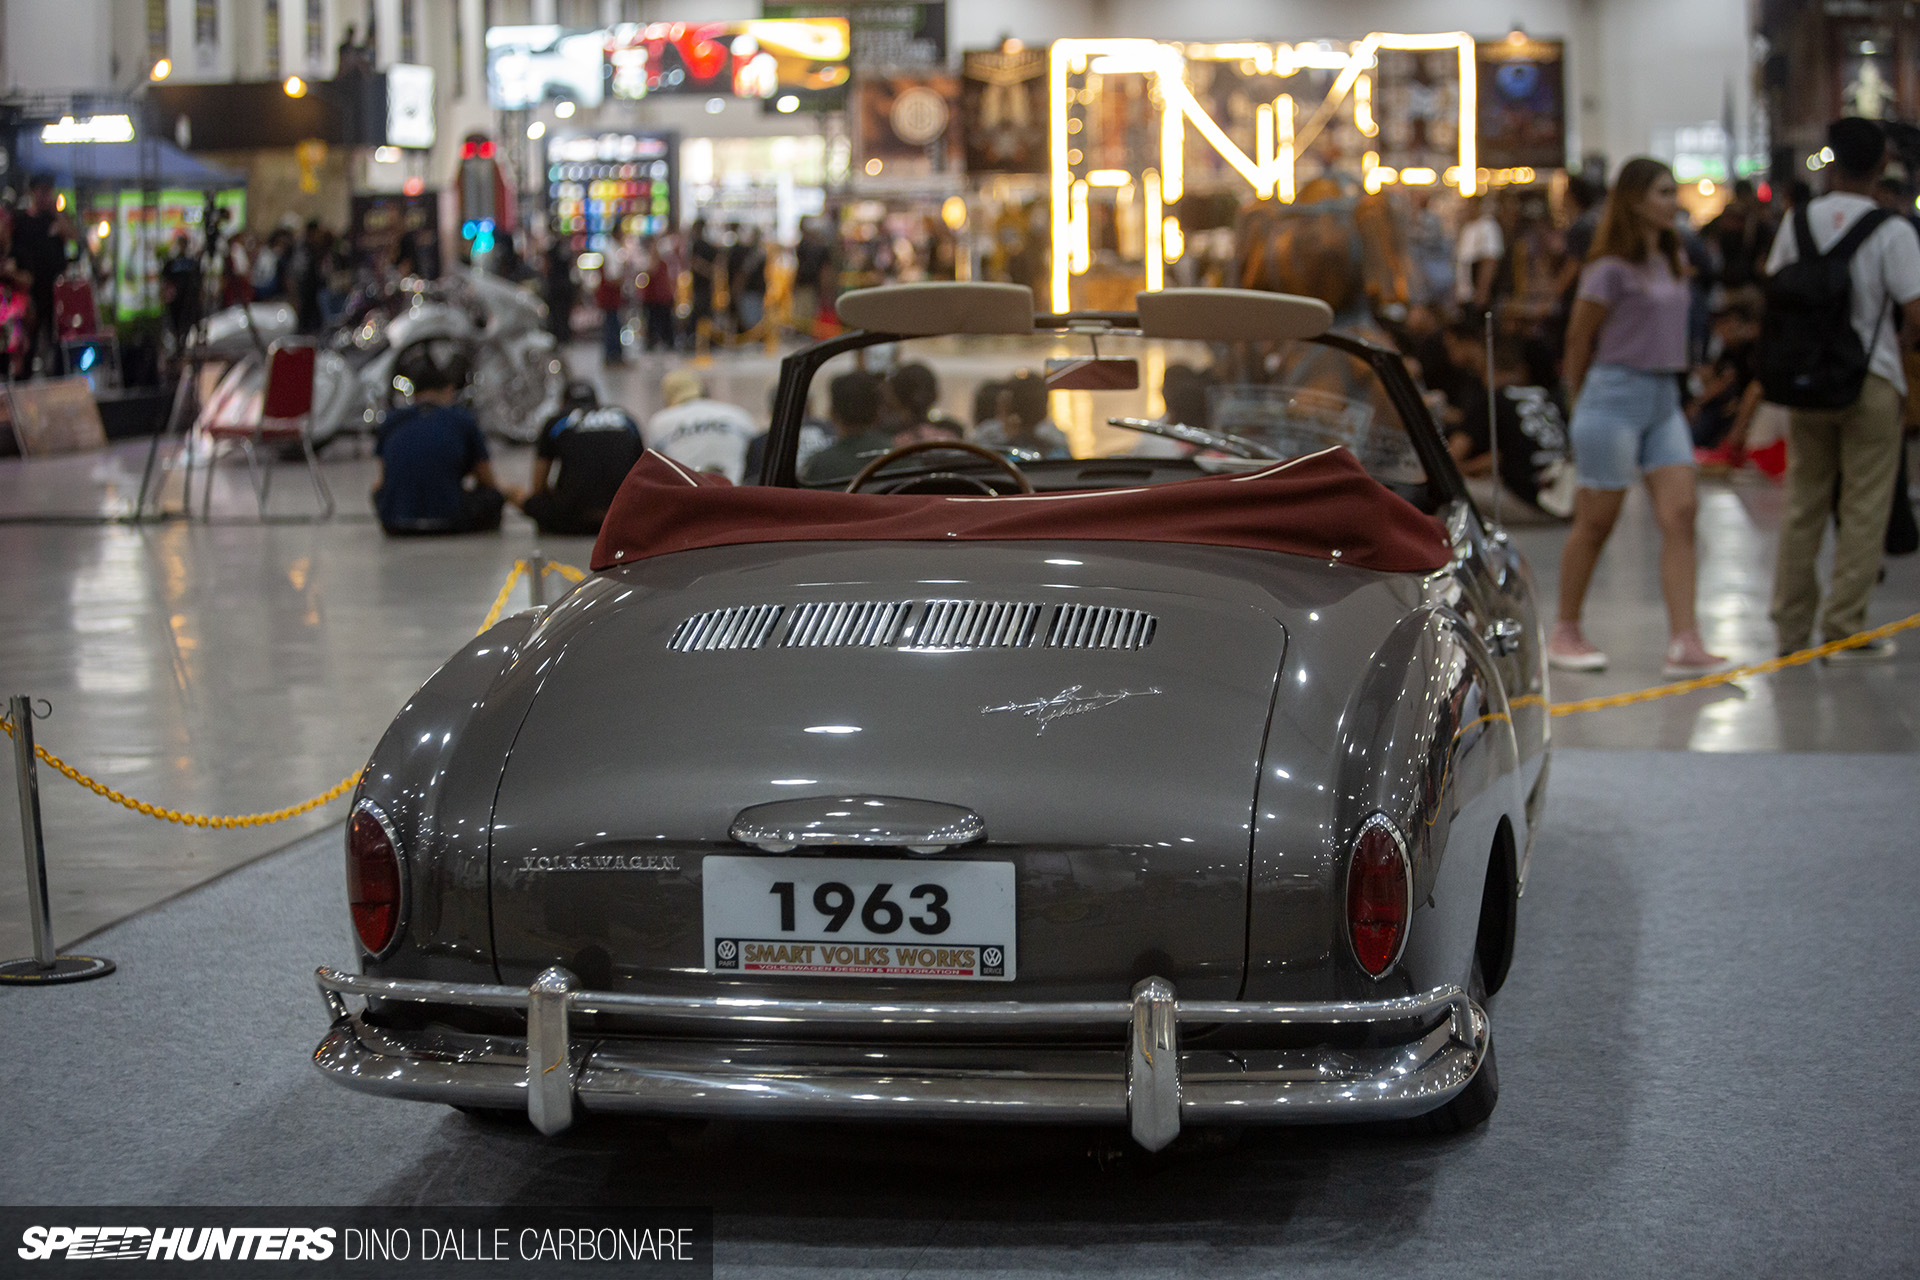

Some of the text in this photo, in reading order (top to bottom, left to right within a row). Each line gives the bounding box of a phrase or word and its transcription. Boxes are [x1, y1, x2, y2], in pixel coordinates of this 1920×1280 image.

[519, 855, 680, 871] VOLKSWAGEN
[769, 882, 951, 935] 1963
[744, 944, 976, 969] SMART VOLKS WORKS
[759, 964, 832, 972] VOLKSWAGEN
[886, 968, 960, 976] RESTORATION
